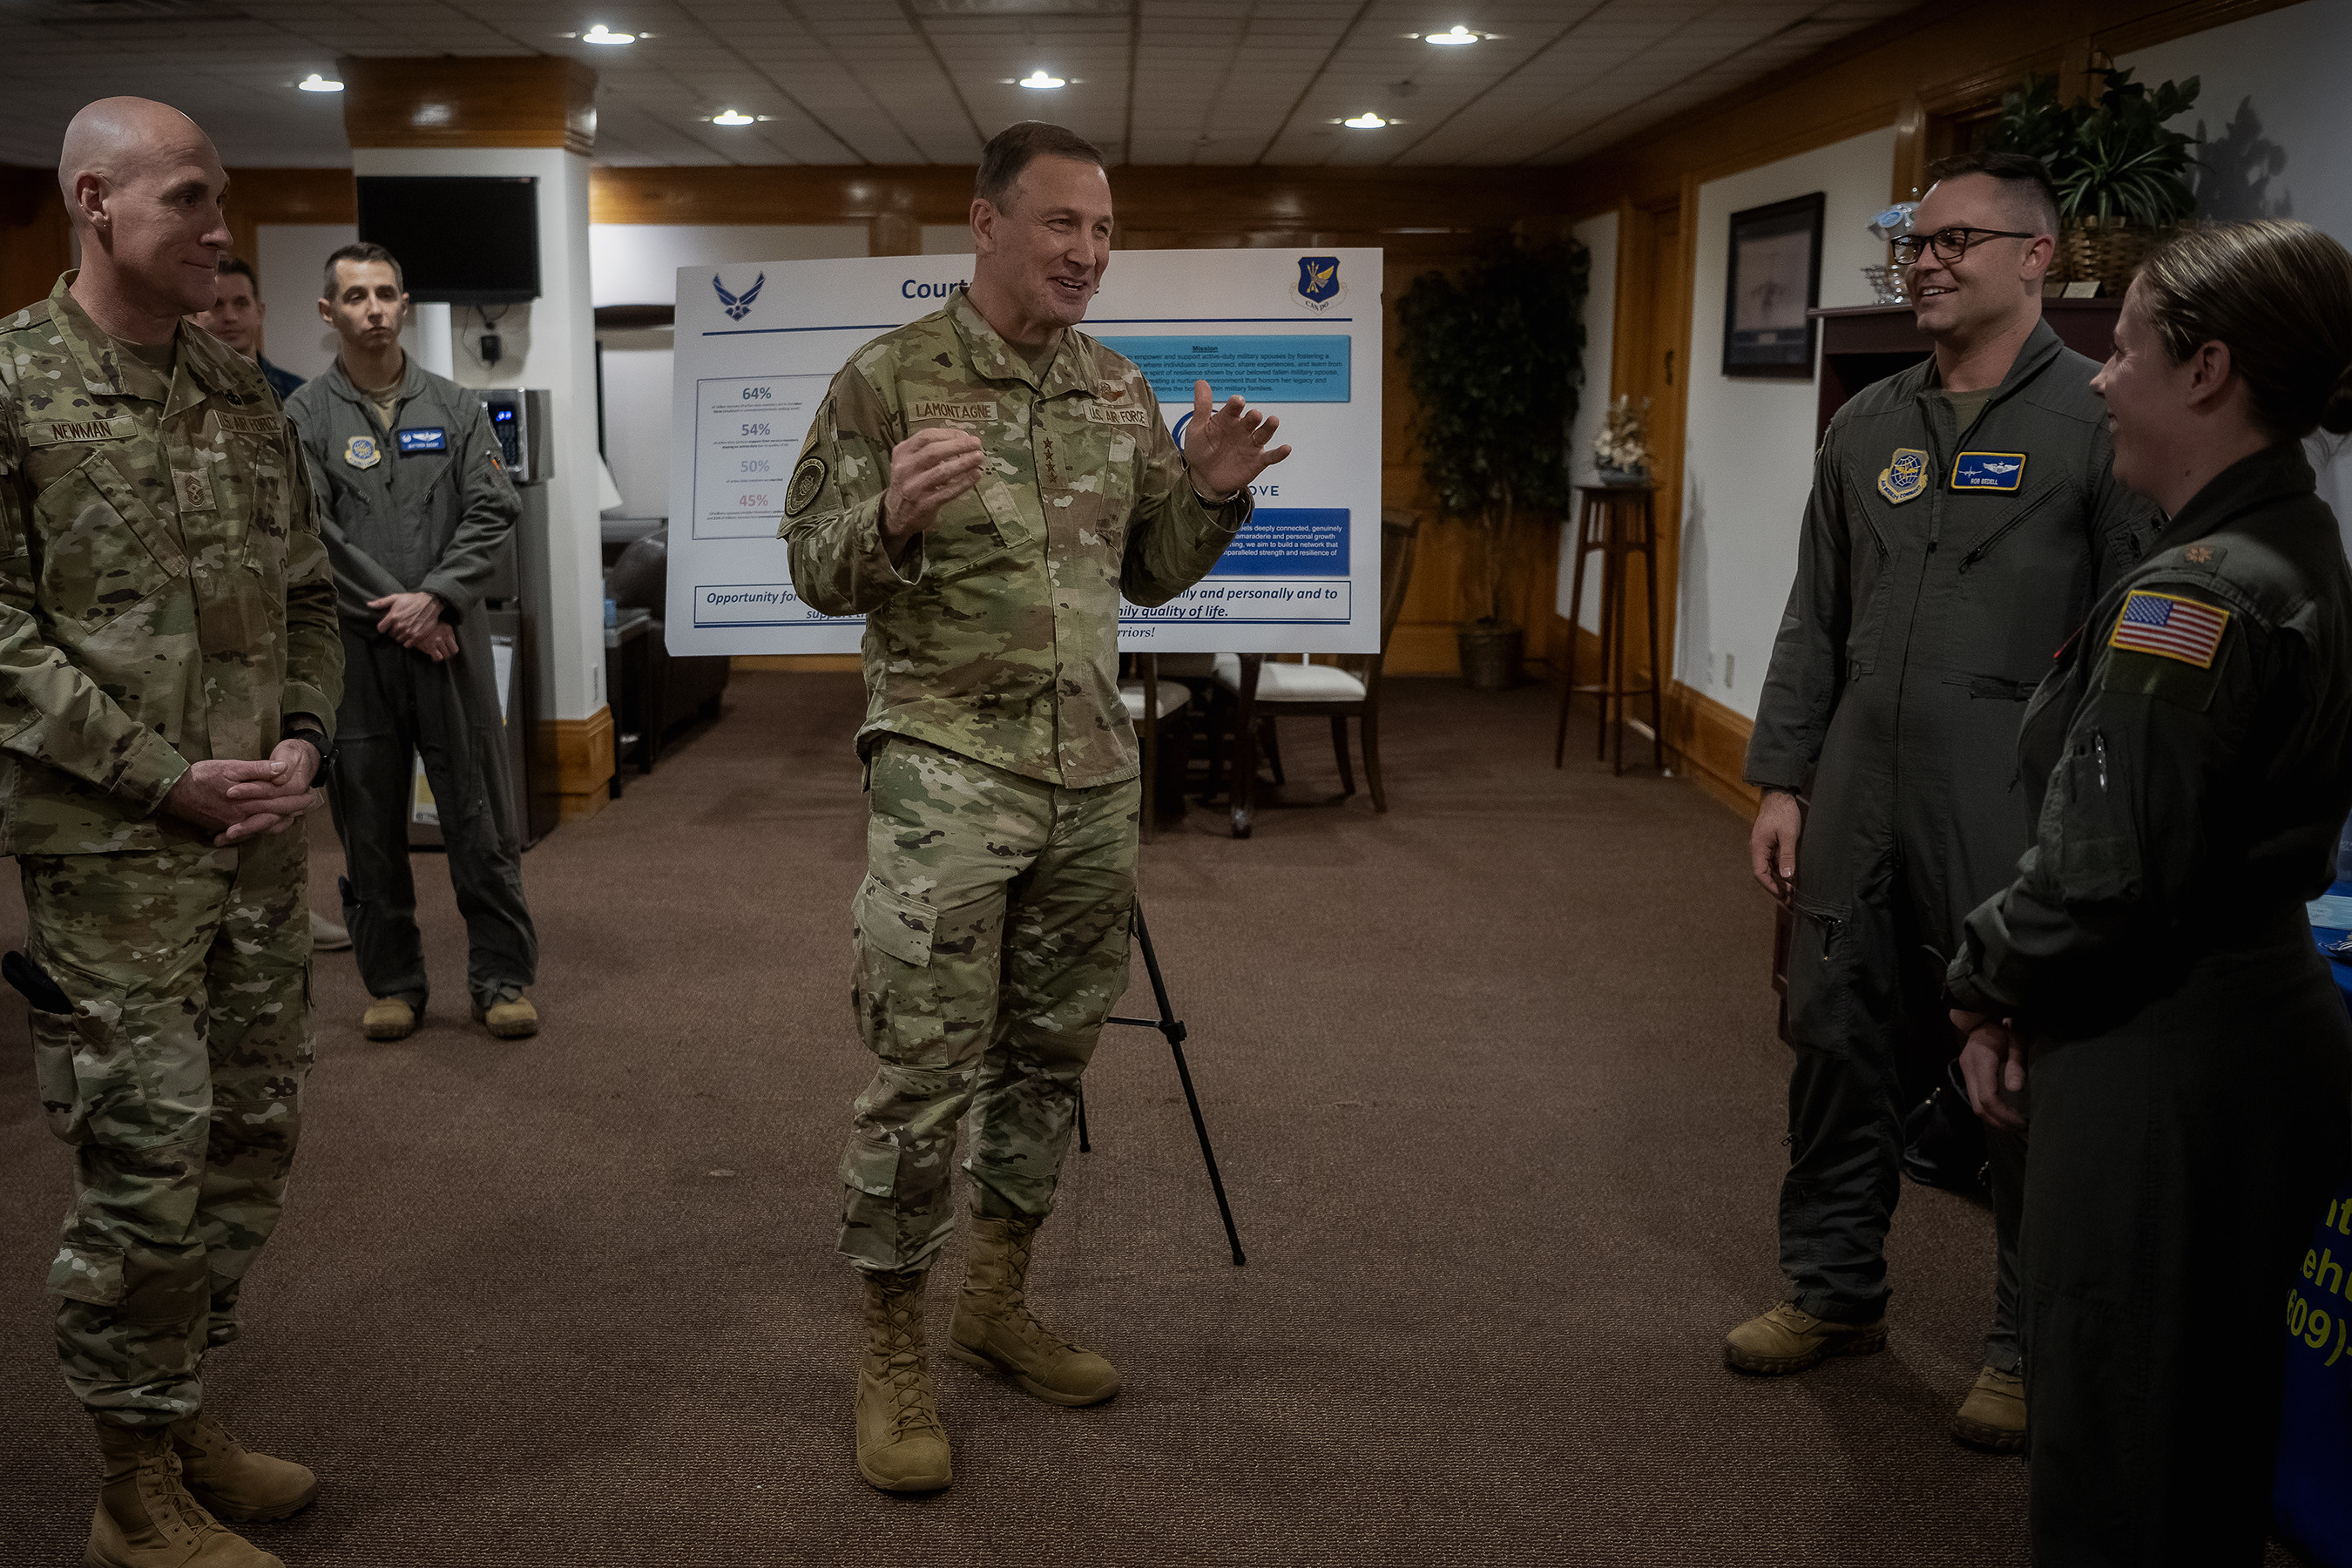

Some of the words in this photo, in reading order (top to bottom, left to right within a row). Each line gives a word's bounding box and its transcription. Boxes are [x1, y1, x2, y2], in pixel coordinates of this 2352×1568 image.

[902, 280, 969, 299] Court
[1306, 301, 1319, 311] CAN
[1320, 302, 1328, 311] DO
[742, 387, 772, 400] 64%
[916, 402, 992, 418] LAMONTAGNE
[1105, 410, 1120, 423] AIR
[1120, 410, 1146, 424] FORCE
[51, 421, 113, 440] NEWMAN
[233, 416, 250, 431] AIR
[248, 416, 281, 431] FORCE
[741, 423, 771, 436] 54%
[740, 459, 770, 473] 50%
[1249, 485, 1280, 497] OVE
[739, 494, 768, 507] 45%
[706, 591, 780, 605] Opportunity
[1200, 587, 1225, 598] and
[1227, 587, 1294, 601] personally
[1296, 588, 1323, 599] and
[1325, 589, 1338, 599] to
[1141, 605, 1186, 618] quality
[1189, 605, 1203, 618] of
[1206, 605, 1228, 618] life.
[1118, 627, 1156, 637] rriors!
